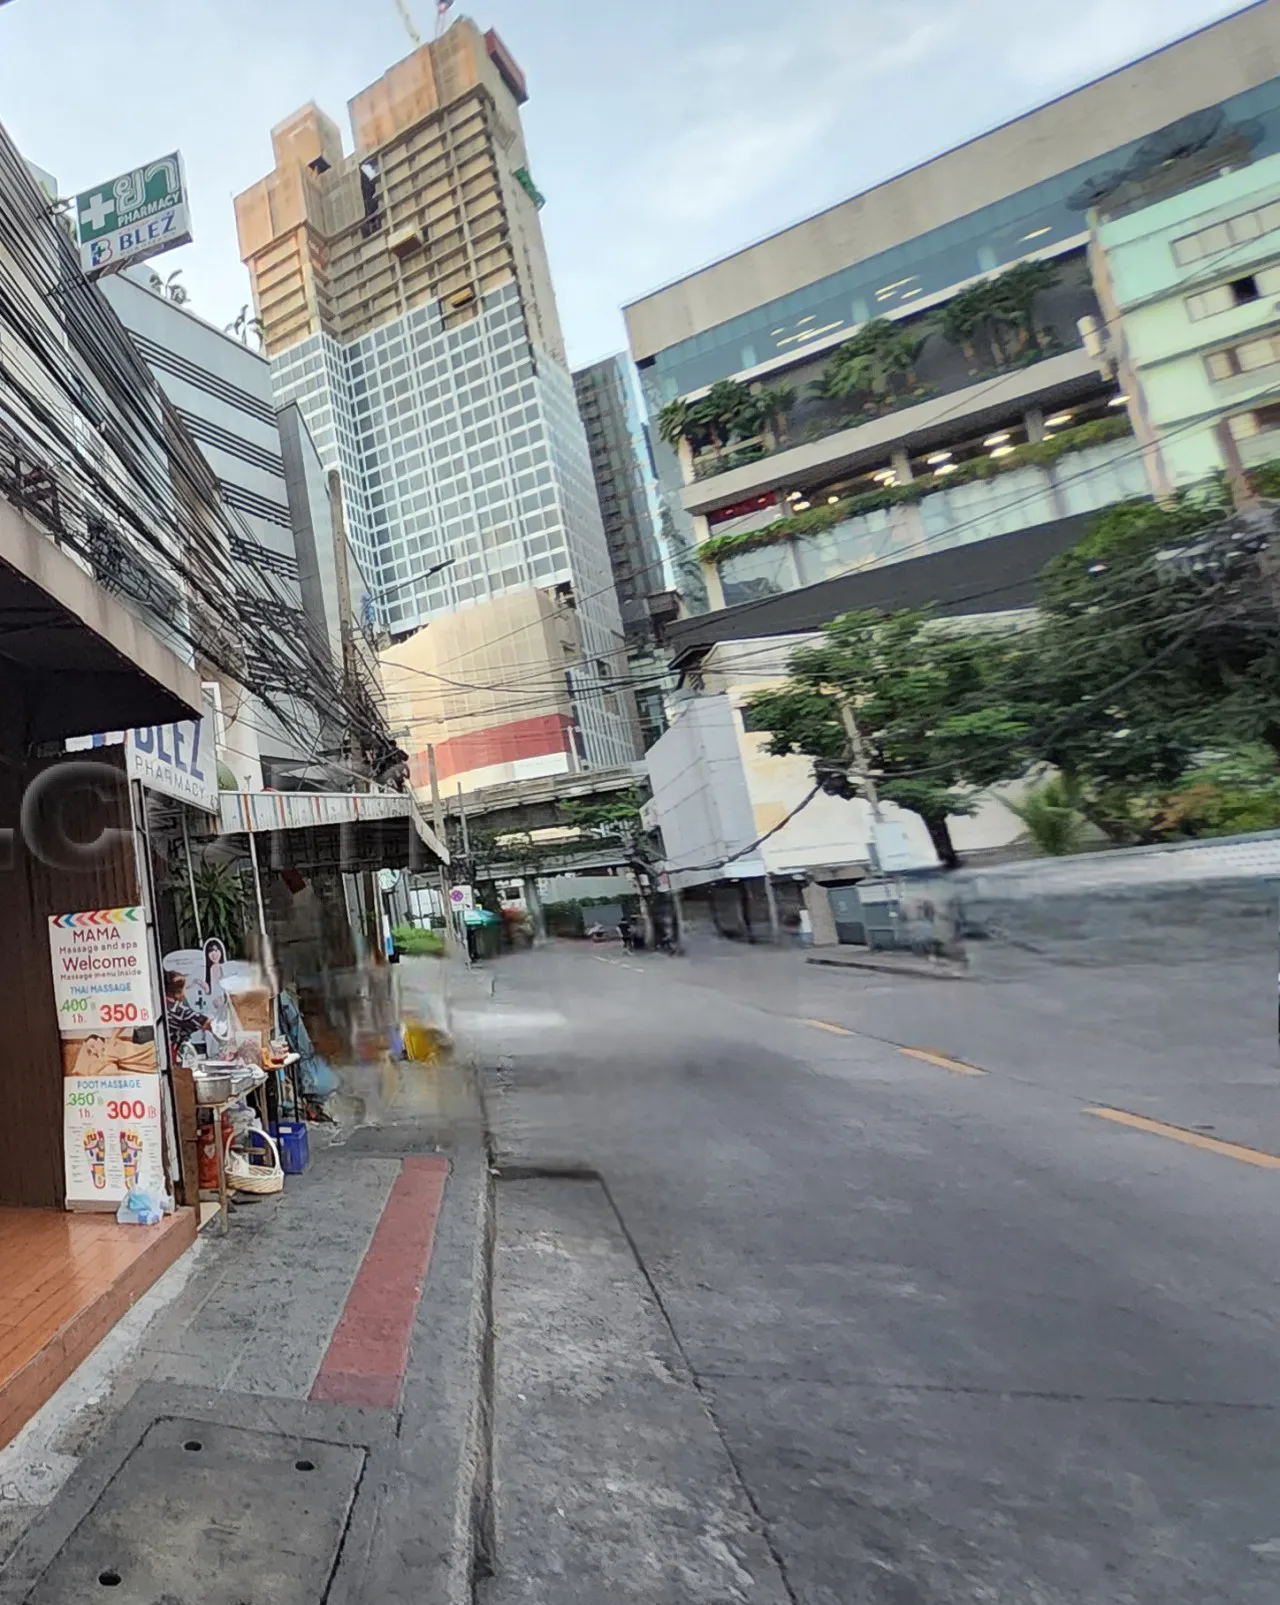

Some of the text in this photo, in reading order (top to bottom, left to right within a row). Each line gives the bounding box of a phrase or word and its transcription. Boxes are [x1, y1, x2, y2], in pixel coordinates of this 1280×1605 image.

[113, 157, 179, 214] ยา
[118, 191, 179, 226] PHARMACY
[120, 210, 176, 250] BLEZ
[135, 755, 205, 799] PHARMACY
[73, 927, 121, 943] MAMA
[59, 942, 138, 954] Massage and spa
[62, 955, 137, 972] Welcome
[70, 983, 132, 995] THAI MASSAGE
[100, 1003, 138, 1023] 350
[77, 1079, 142, 1089] FOOT MASSAGE
[68, 1092, 95, 1106] 350
[106, 1100, 146, 1120] 300
